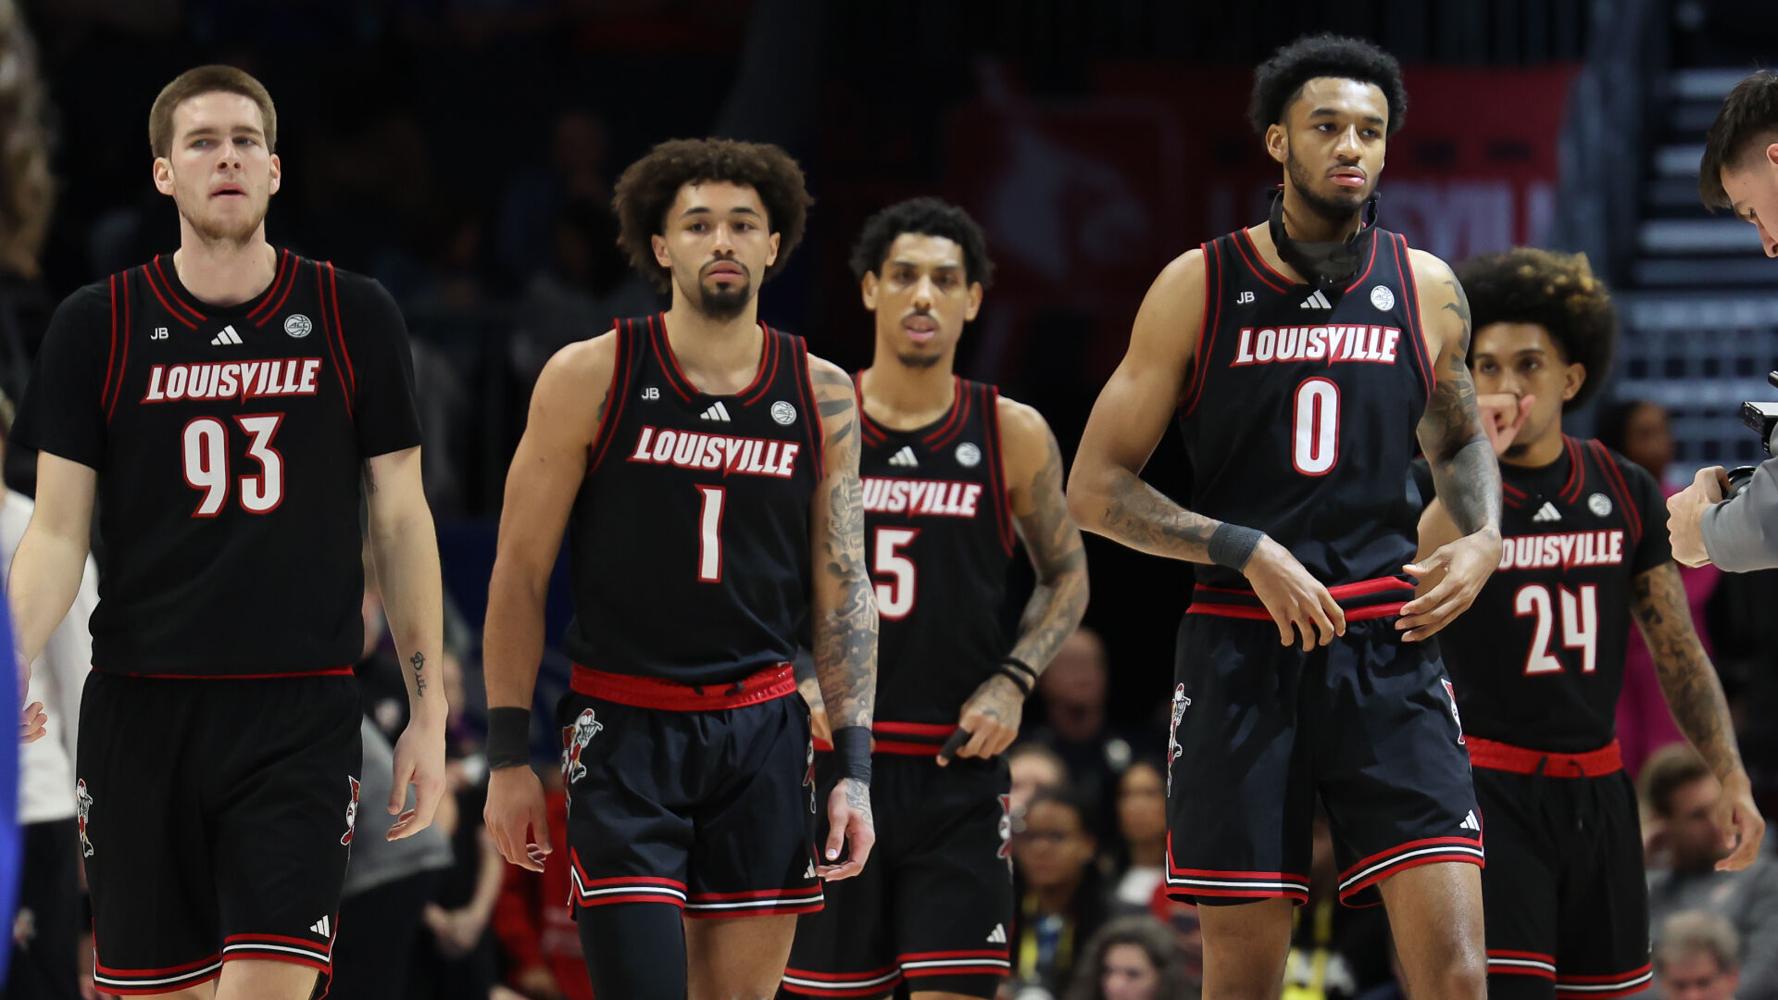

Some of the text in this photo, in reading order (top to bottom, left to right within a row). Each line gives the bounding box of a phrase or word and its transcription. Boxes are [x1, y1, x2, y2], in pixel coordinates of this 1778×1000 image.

[1236, 291, 1255, 305] JB
[150, 327, 169, 340] JB
[1231, 324, 1400, 367] LOUISVILLE
[141, 358, 322, 404] LOUISVILLE
[641, 388, 660, 400] JB
[1293, 377, 1341, 477] 0
[182, 412, 286, 517] 93
[628, 425, 801, 478] LOUISVILLE
[861, 476, 984, 519] UISVILLE
[695, 484, 726, 583] 1
[1498, 530, 1625, 573] OUISVILLE
[874, 526, 921, 621] 5
[1514, 583, 1600, 676] 24
